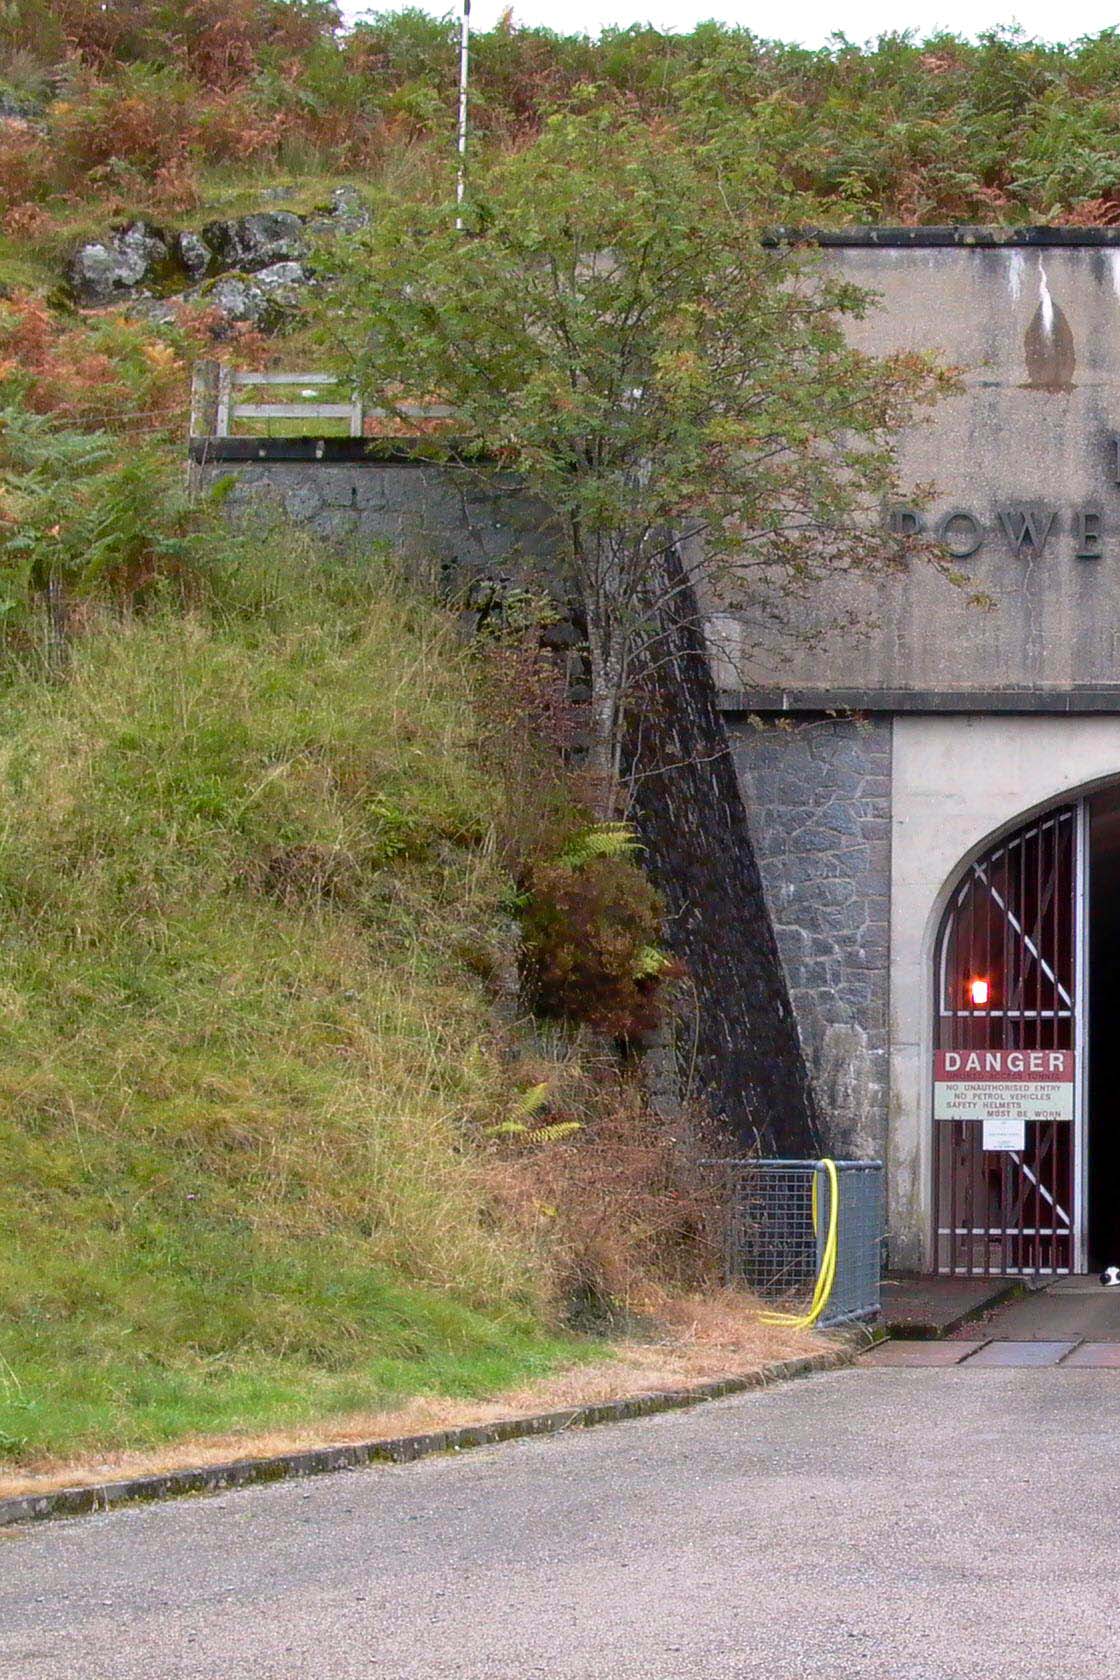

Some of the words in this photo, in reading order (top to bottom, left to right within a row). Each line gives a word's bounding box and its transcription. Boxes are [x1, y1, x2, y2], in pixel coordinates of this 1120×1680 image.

[944, 1052, 1064, 1072] DANGER
[946, 1084, 959, 1092] NO
[963, 1084, 1030, 1092] UNAUTHORISED
[1034, 1084, 1061, 1092] ENTRY
[954, 1092, 967, 1101] NO
[972, 1092, 1005, 1101] PETROL
[1009, 1092, 1052, 1101] VEHICLES
[946, 1101, 977, 1109] SAFETY
[982, 1101, 1022, 1109] HELMETS
[987, 1110, 1011, 1118] MUST
[1016, 1110, 1028, 1118] BE
[1034, 1110, 1061, 1118] WORN
